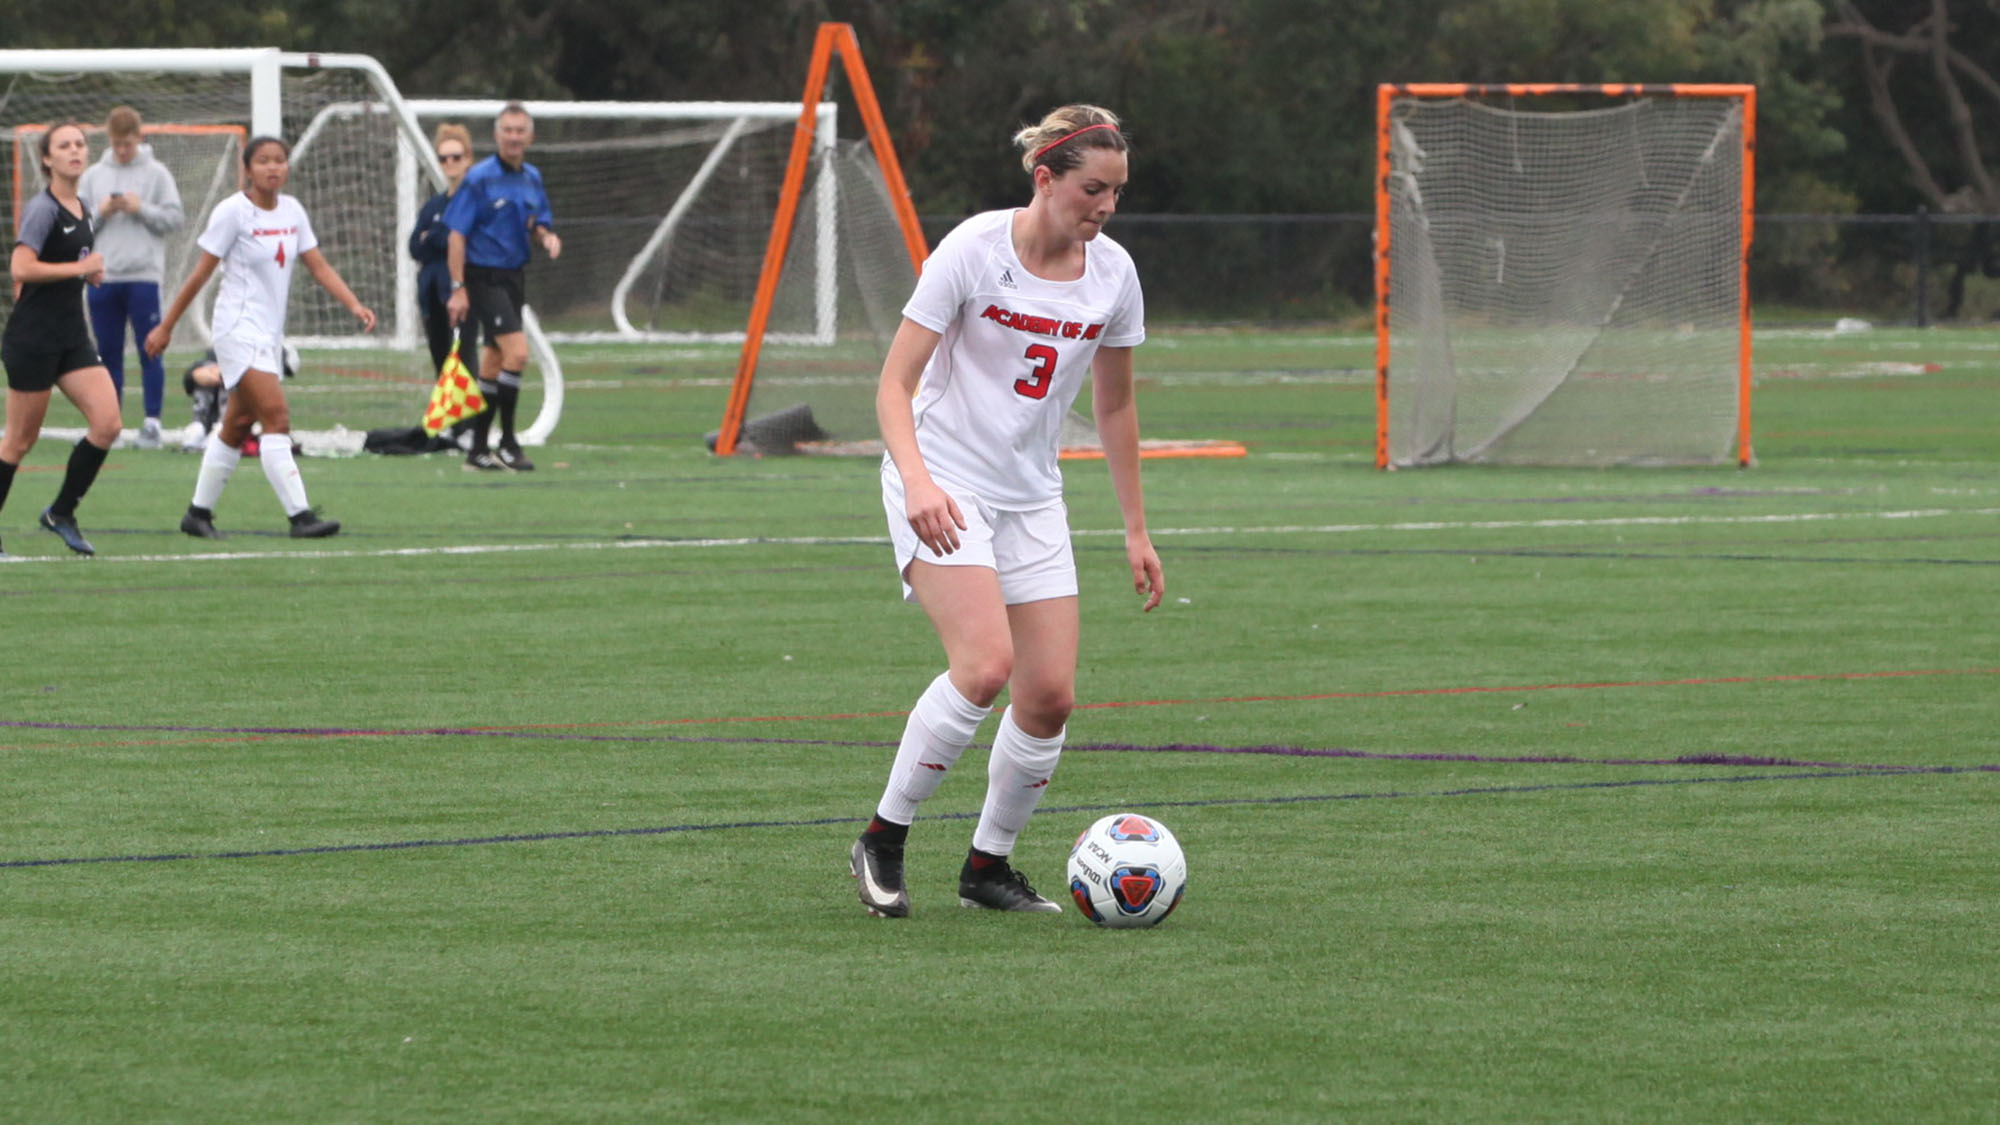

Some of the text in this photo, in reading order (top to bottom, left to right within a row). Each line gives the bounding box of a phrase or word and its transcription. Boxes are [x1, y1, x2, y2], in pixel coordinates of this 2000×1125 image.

[274, 241, 285, 268] 4
[980, 304, 1062, 336] ACADEMY
[1062, 321, 1082, 339] OF
[1014, 343, 1058, 400] 3
[1087, 841, 1112, 864] NCAA
